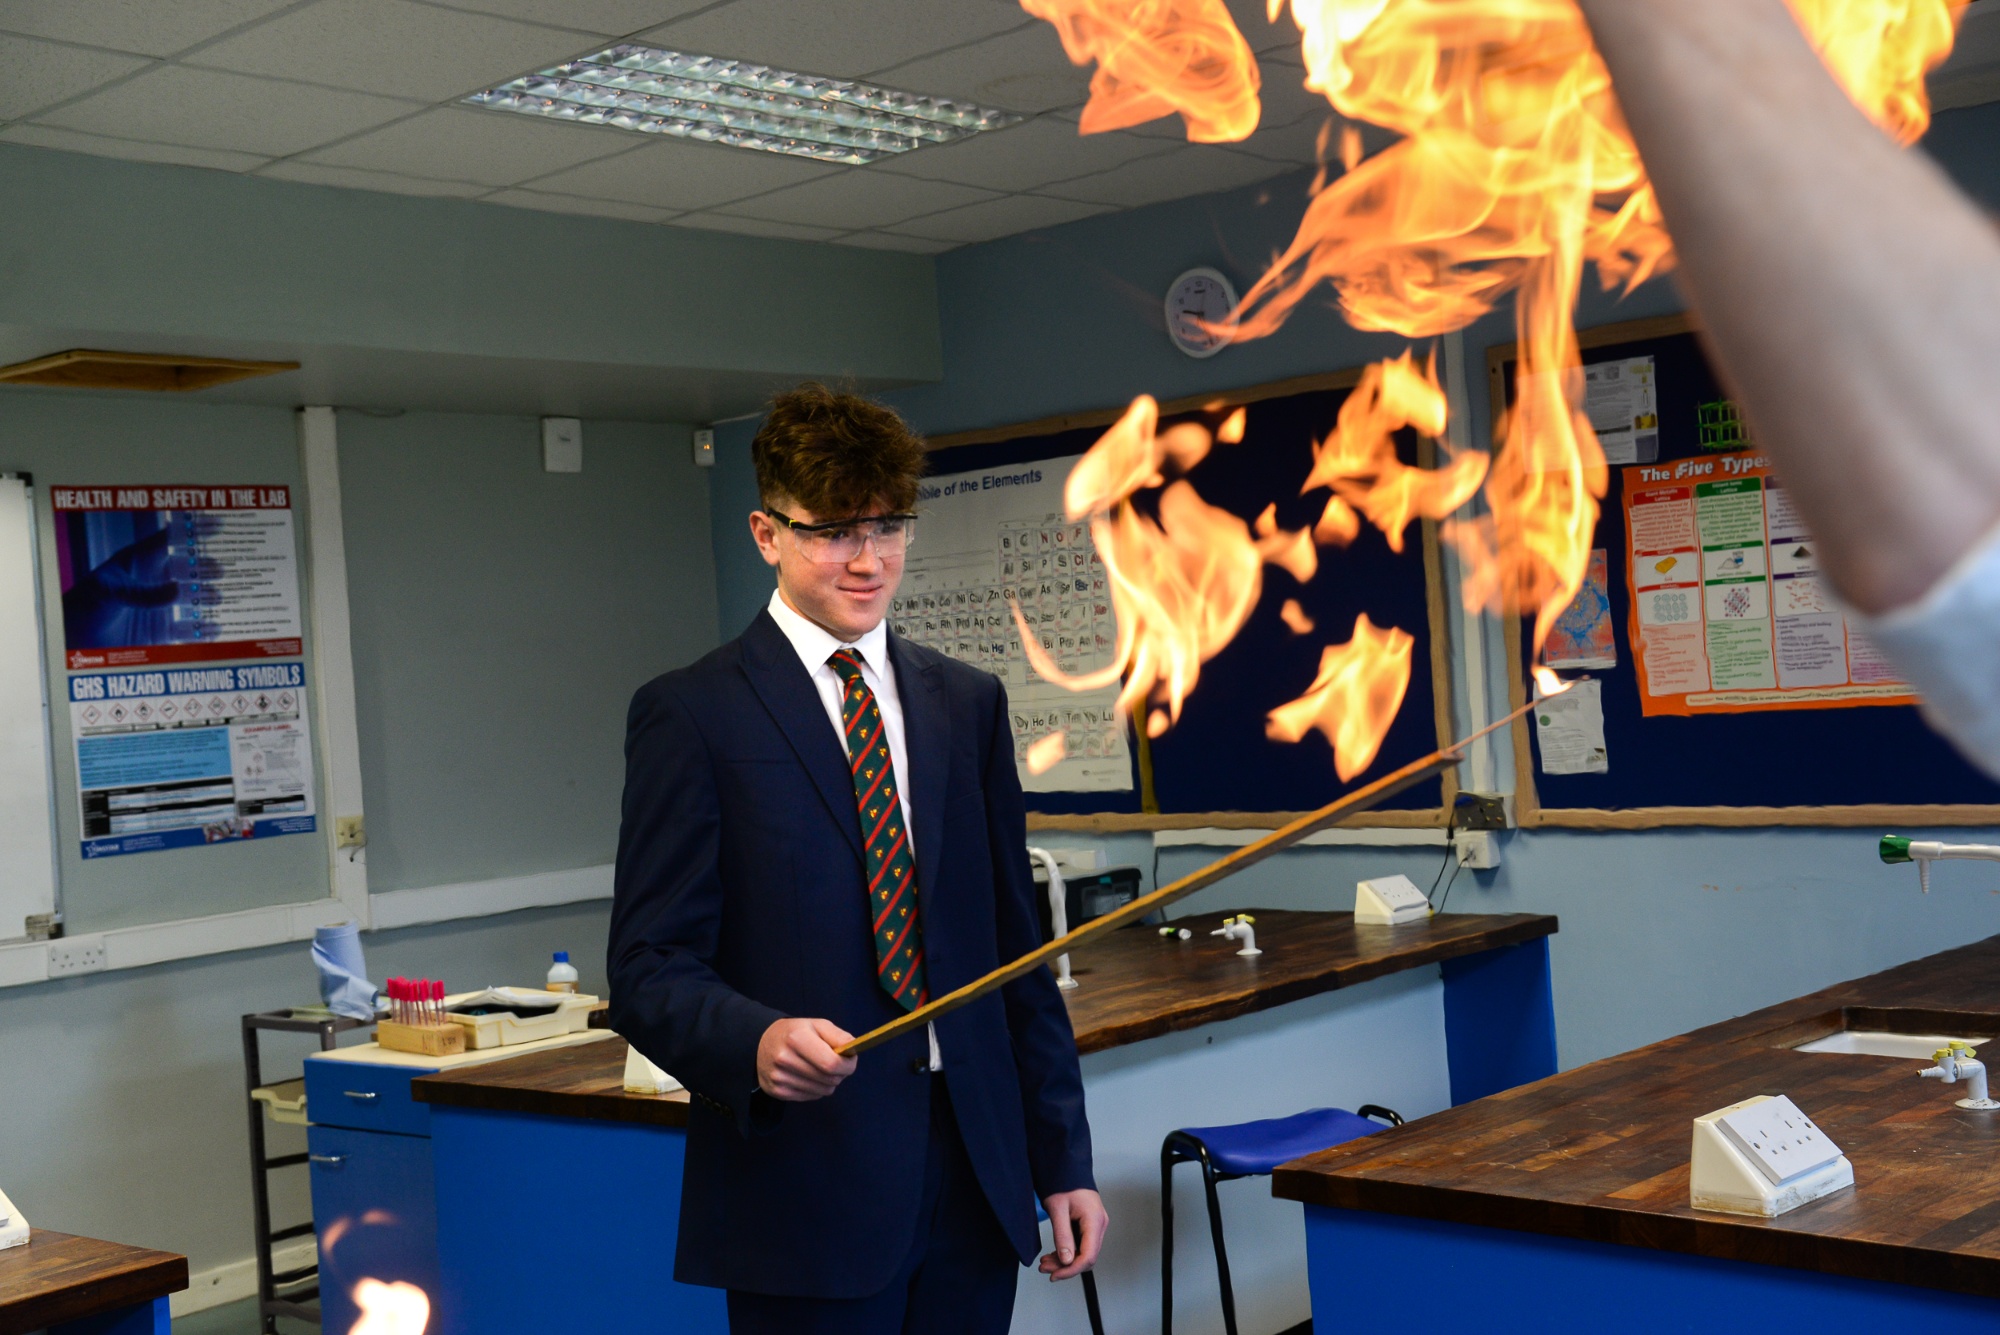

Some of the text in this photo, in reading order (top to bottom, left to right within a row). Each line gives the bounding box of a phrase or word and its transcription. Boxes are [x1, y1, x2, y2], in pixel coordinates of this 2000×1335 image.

[1640, 456, 1771, 482] The Five Types
[944, 481, 956, 496] of
[960, 480, 978, 493] the
[983, 469, 1042, 490] Elements
[54, 489, 287, 508] HEALTH AND SAFETY IN THE LAB
[1003, 528, 1081, 548] B C N O F
[1004, 563, 1013, 574] Al
[1022, 561, 1031, 571] Si
[1042, 559, 1047, 568] P
[1058, 555, 1067, 567] S
[1074, 555, 1084, 566] Cl
[893, 601, 902, 612] Cr
[923, 598, 935, 609] Fe
[957, 594, 965, 603] Ni
[970, 593, 982, 603] Cu
[988, 590, 999, 602] Zn
[1003, 588, 1015, 599] Ga
[1041, 585, 1051, 595] As
[1093, 580, 1104, 590] Kr
[926, 622, 937, 631] Ru
[974, 618, 984, 629] Ag
[988, 616, 1001, 626] Cd
[978, 644, 989, 653] Au
[992, 643, 1004, 654] Hg
[1043, 639, 1053, 649] Bi
[72, 665, 300, 700] GHS HAZARD WARNING SYMBOLS
[1015, 716, 1028, 730] Dy
[1033, 718, 1044, 726] Ho
[1103, 711, 1114, 721] Lu
